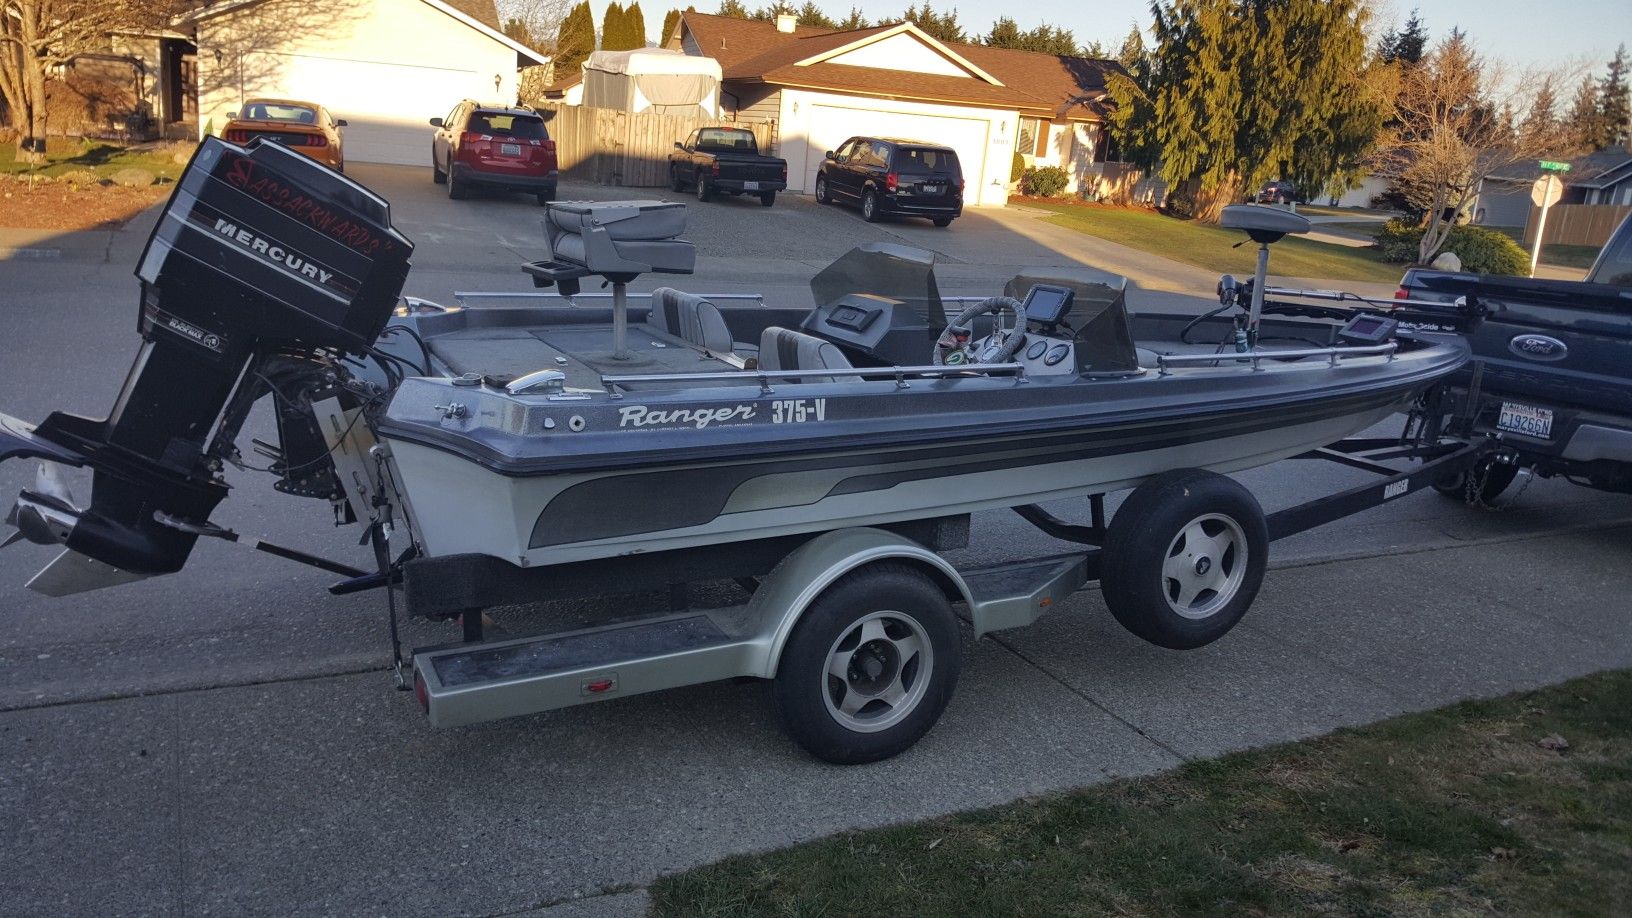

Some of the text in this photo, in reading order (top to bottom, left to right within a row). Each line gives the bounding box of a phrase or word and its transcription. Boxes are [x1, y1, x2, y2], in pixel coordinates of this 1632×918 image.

[214, 218, 334, 284] MERCURY
[169, 320, 189, 334] BLACK
[618, 398, 826, 430] Ranger 375-V
[1500, 411, 1551, 436] C19266N
